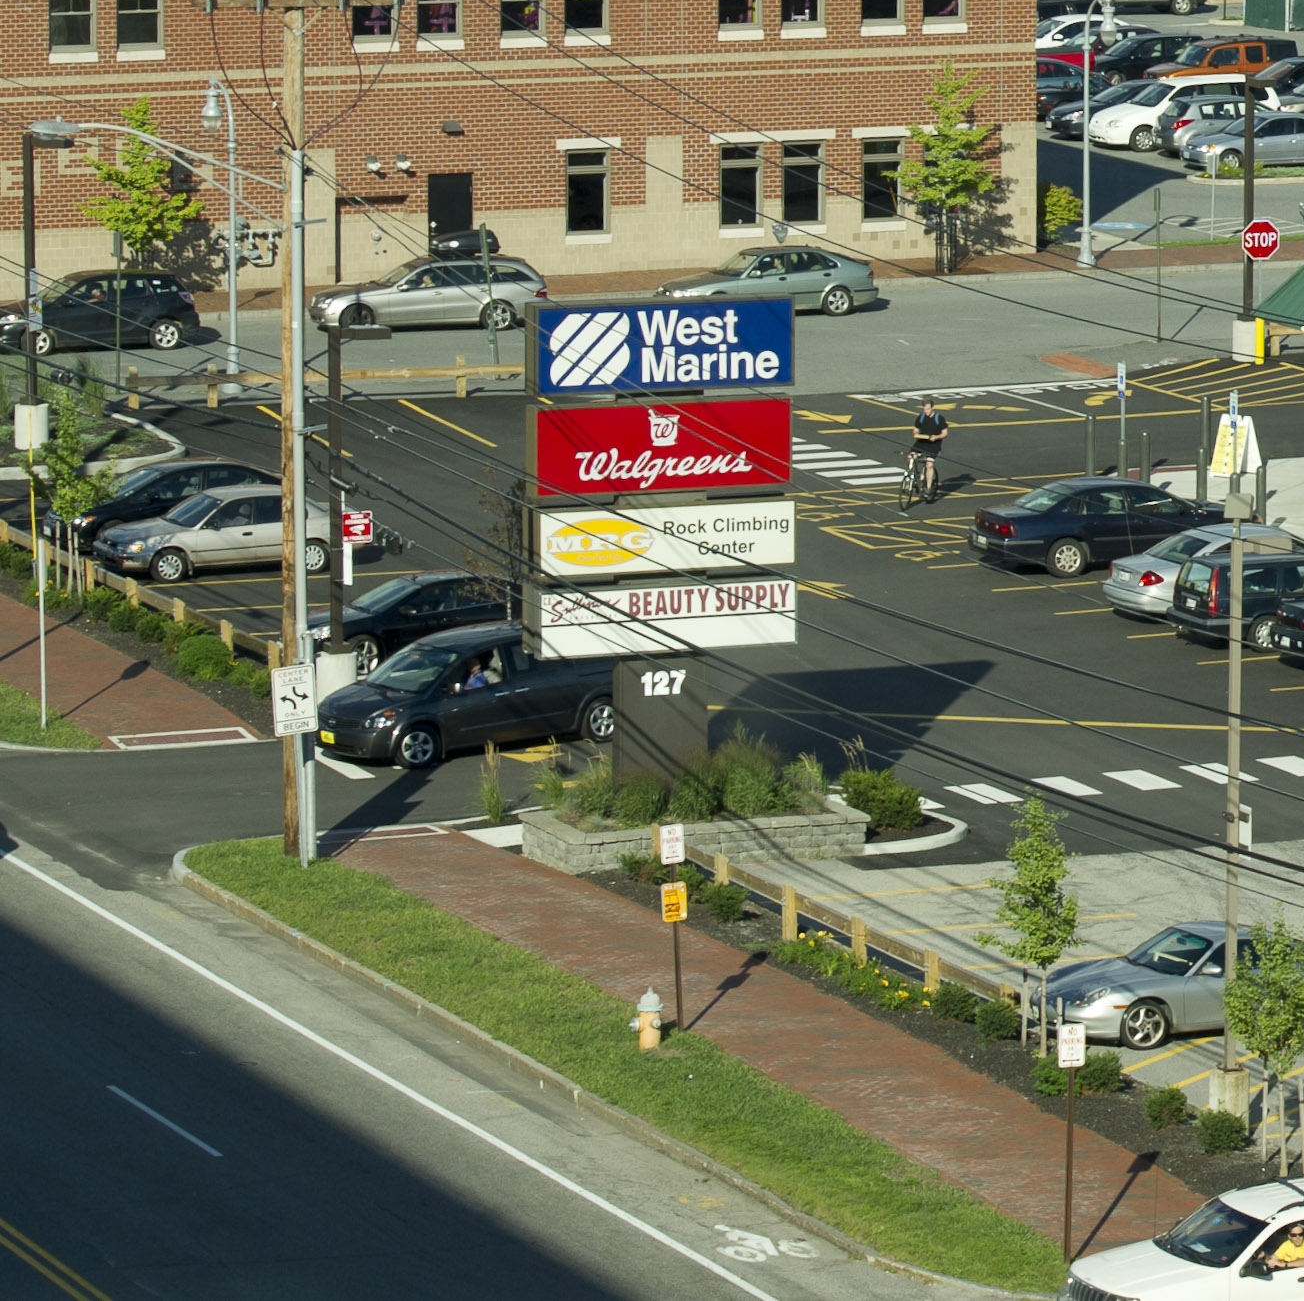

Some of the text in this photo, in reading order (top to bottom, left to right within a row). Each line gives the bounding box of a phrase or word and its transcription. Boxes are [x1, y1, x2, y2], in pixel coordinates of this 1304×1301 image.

[1244, 231, 1277, 248] STOP
[637, 309, 738, 346] West
[640, 344, 780, 384] Marine
[575, 448, 753, 489] Walgreens
[663, 517, 790, 536] Rock Climbing
[699, 541, 756, 556] Center
[629, 583, 790, 618] BEAUTY SUPPLY
[278, 668, 309, 678] CENTER
[283, 676, 304, 684] LANE
[641, 669, 687, 696] 127
[284, 710, 306, 718] ONLY
[283, 720, 310, 732] BEGIN
